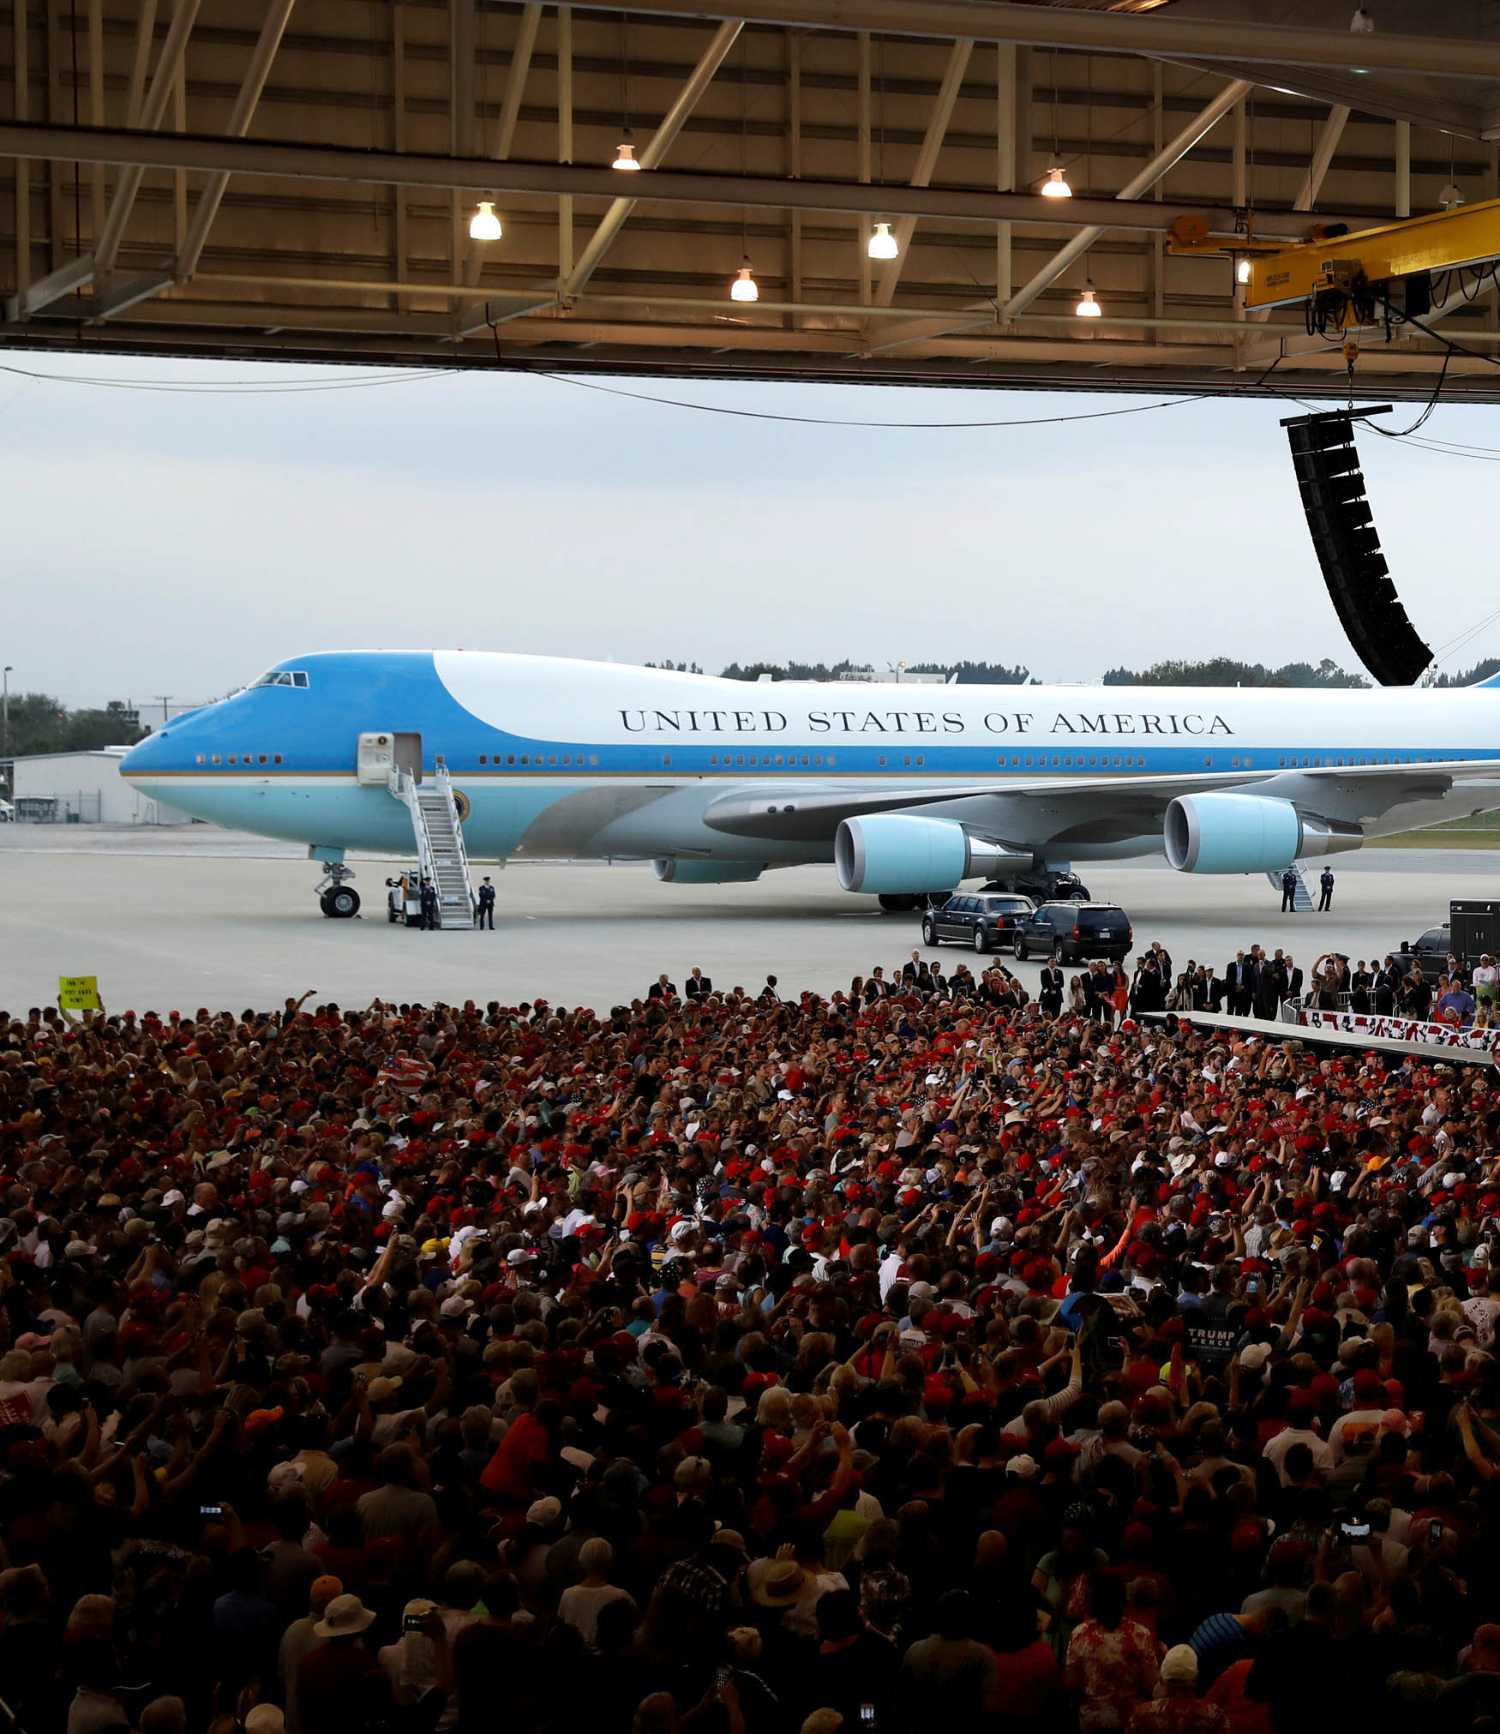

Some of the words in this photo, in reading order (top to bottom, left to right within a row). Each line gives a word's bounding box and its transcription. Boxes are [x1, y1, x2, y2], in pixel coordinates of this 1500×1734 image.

[618, 710, 788, 731] UNITED
[808, 711, 965, 732] STATES
[983, 713, 1033, 732] OF
[1049, 713, 1235, 734] AMERICA
[1187, 1328, 1235, 1341] TRUMP
[1191, 1338, 1231, 1346] PENCE
